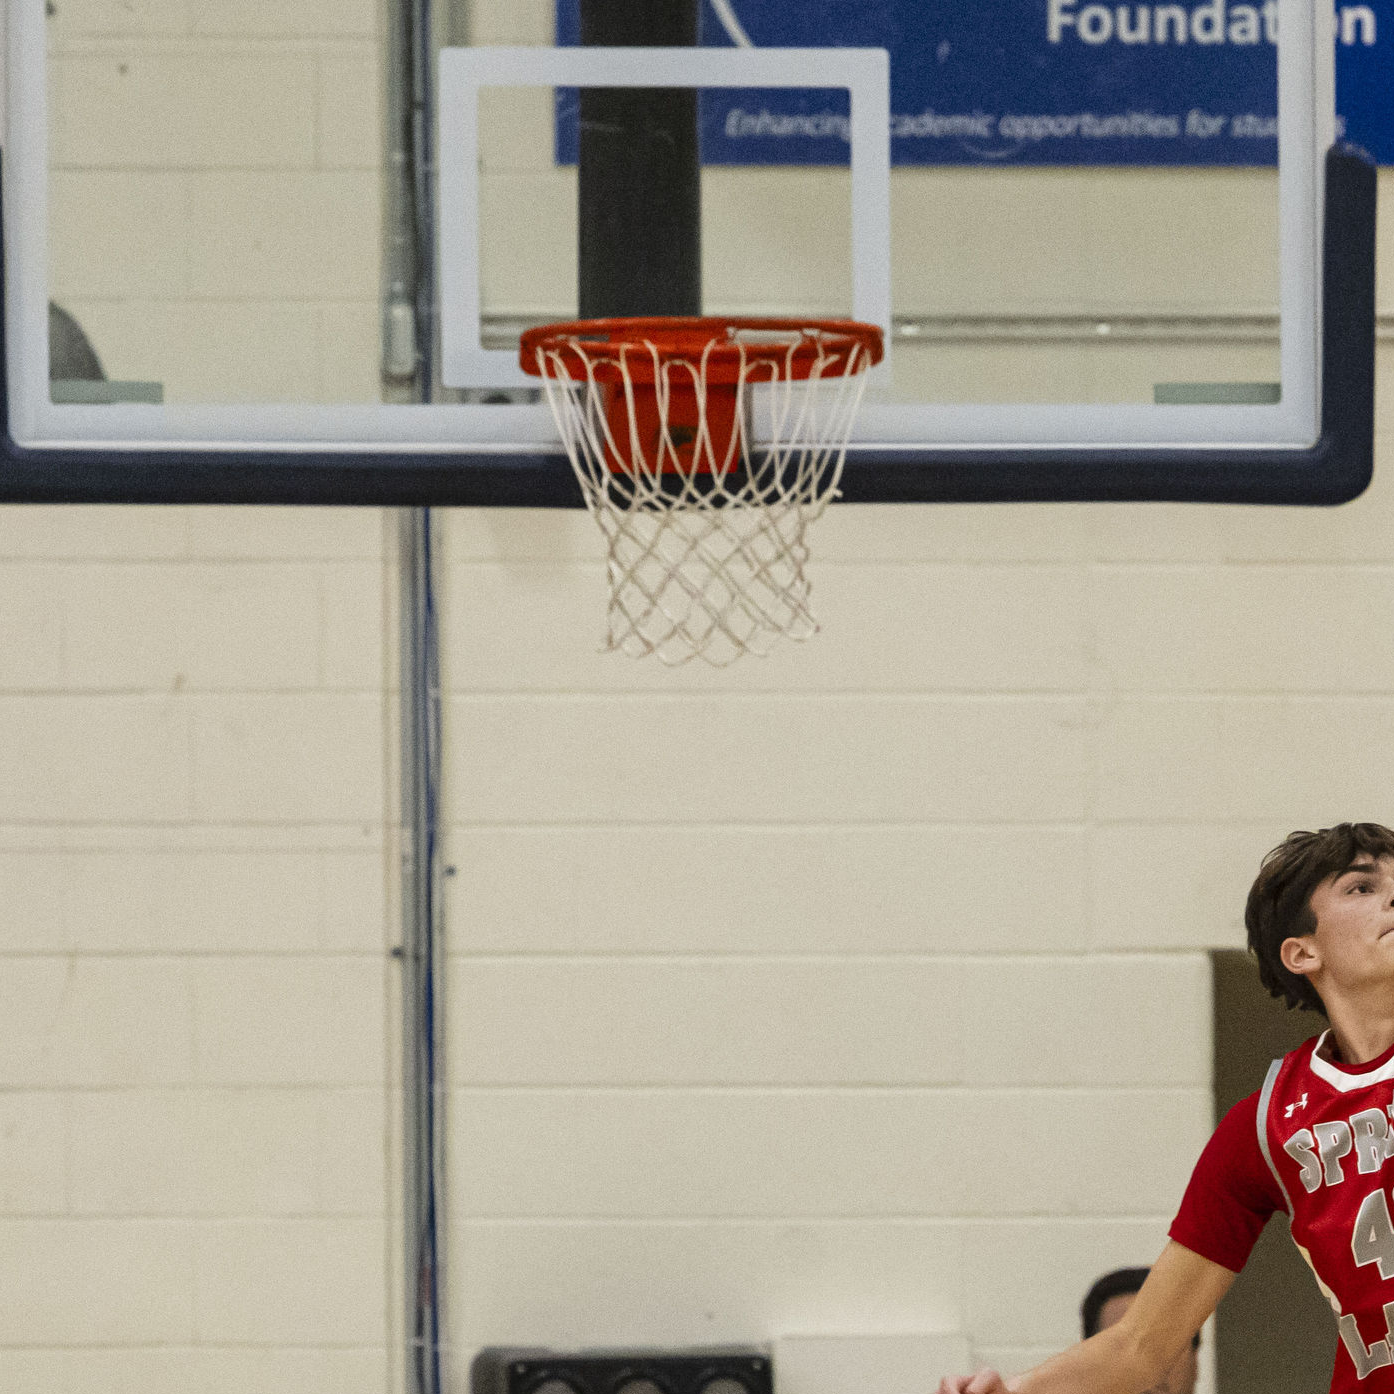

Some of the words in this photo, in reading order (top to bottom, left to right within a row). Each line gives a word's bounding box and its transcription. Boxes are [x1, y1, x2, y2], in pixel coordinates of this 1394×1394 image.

[889, 108, 995, 138] cademic
[998, 109, 1179, 142] opportunities
[1184, 108, 1226, 138] for
